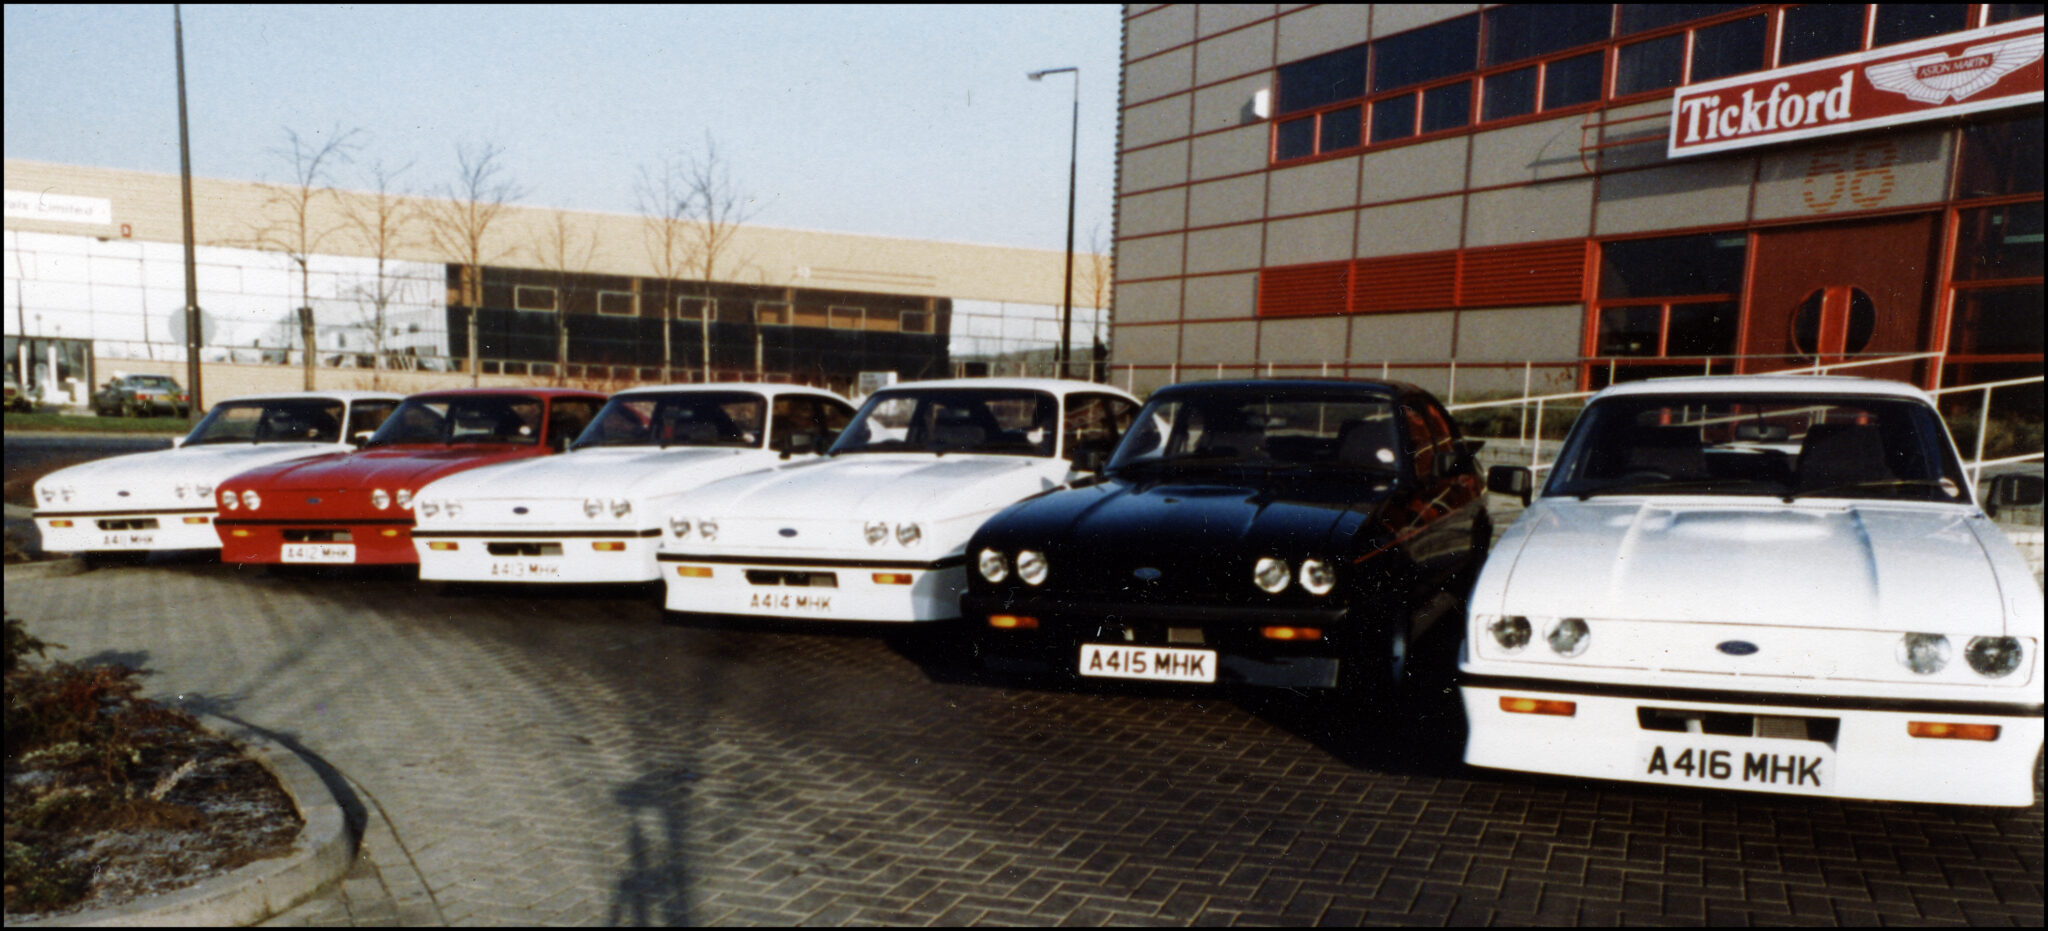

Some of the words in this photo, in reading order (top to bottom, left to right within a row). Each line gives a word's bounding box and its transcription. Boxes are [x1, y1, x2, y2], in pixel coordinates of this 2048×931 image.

[1920, 63, 1950, 77] ASTON
[1953, 56, 1990, 71] MARTIN
[1681, 70, 1854, 143] Tickford
[1803, 141, 1897, 213] 58
[288, 547, 318, 560] A412
[322, 547, 350, 560] MHK
[491, 562, 523, 577] A413
[529, 563, 560, 578] MHK
[750, 593, 789, 609] A414
[796, 595, 833, 612] MHK
[1089, 649, 1147, 674] A415
[1154, 651, 1206, 677] MHK
[1647, 745, 1732, 780] A416
[1743, 752, 1822, 787] MHK
